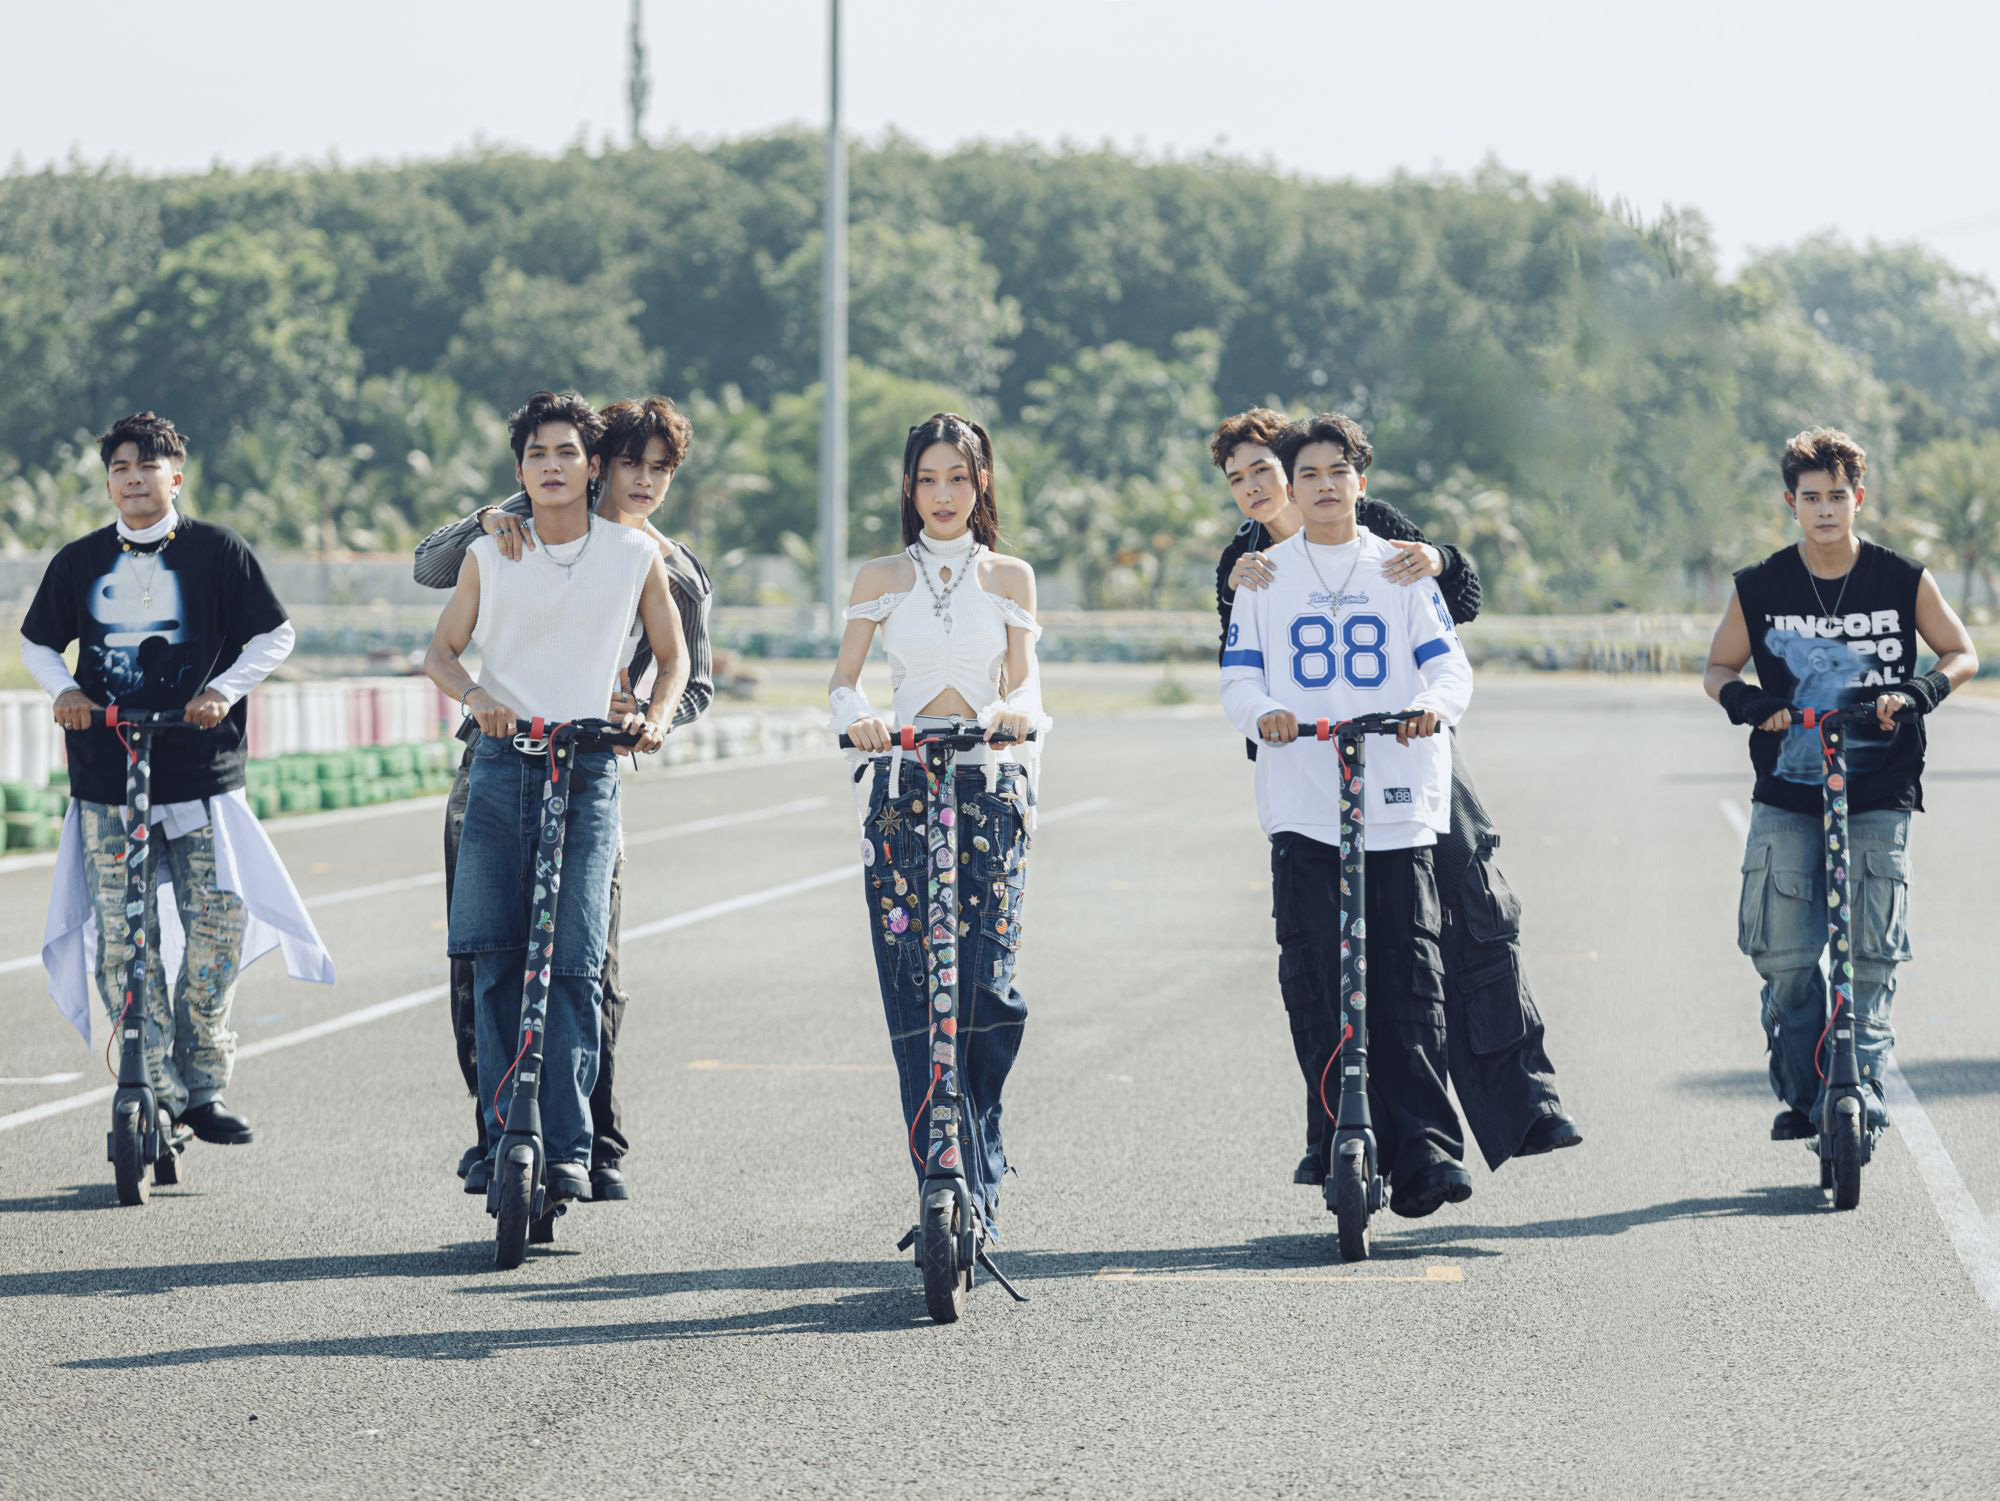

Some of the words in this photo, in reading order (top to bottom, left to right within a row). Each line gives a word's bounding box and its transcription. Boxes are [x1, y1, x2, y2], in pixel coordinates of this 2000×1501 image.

[1228, 623, 1239, 647] 8
[1288, 612, 1390, 691] 88
[1395, 791, 1411, 802] 88
